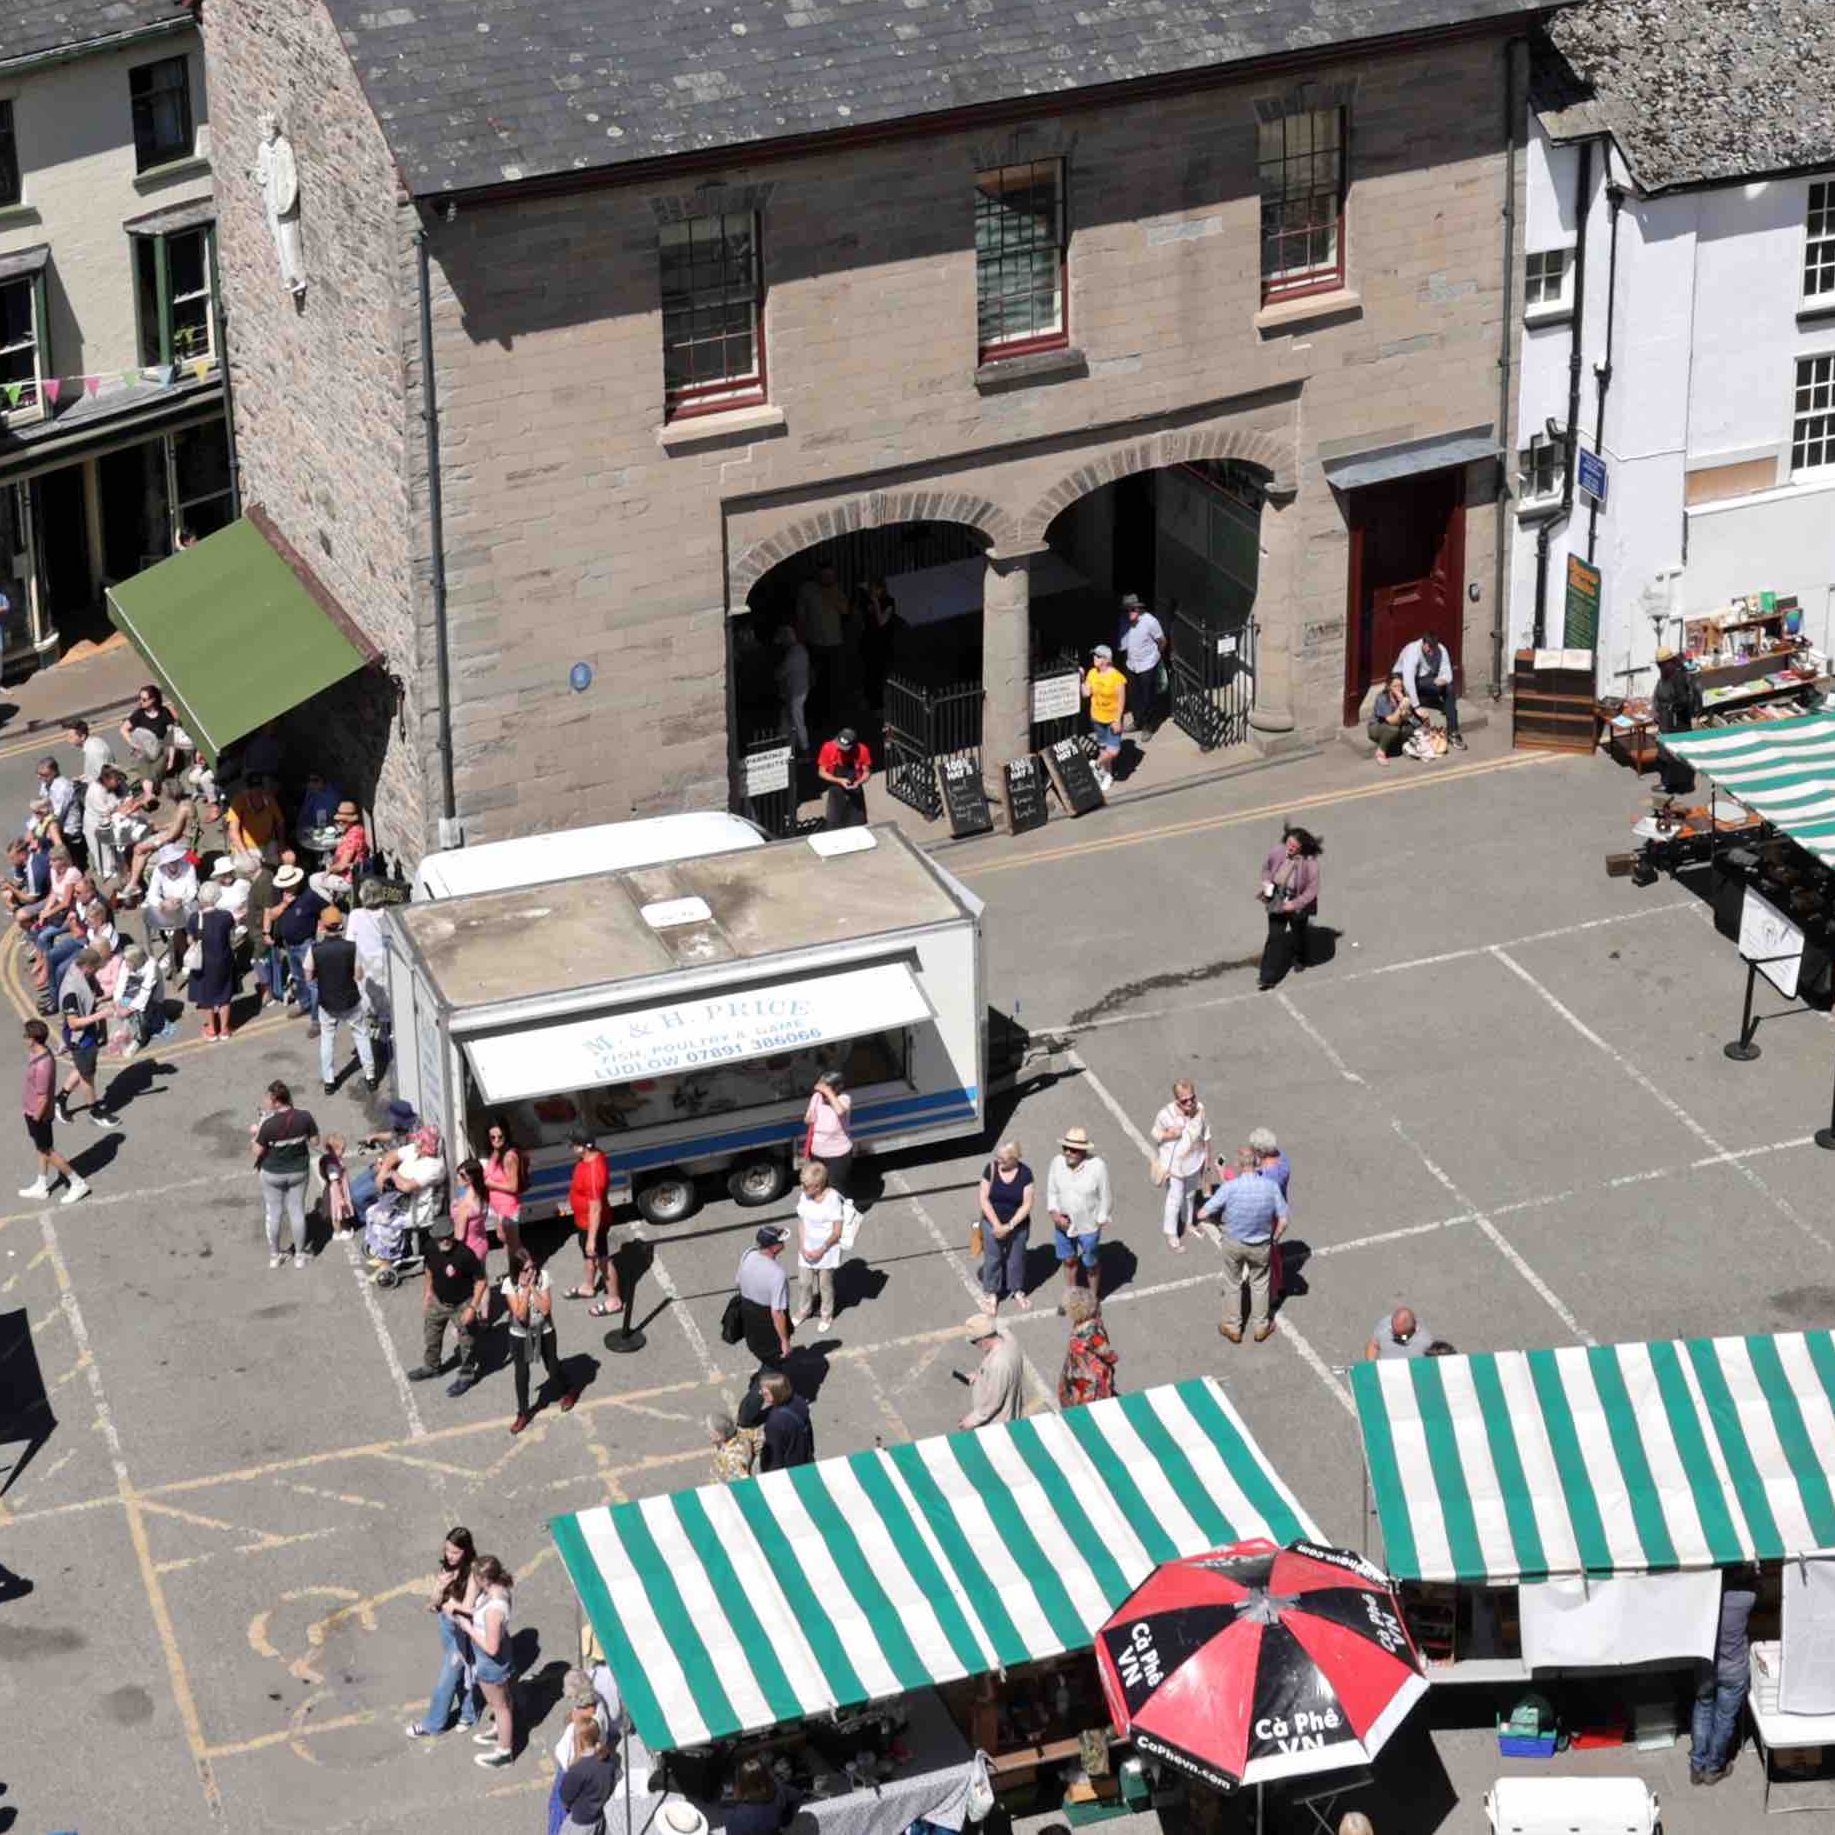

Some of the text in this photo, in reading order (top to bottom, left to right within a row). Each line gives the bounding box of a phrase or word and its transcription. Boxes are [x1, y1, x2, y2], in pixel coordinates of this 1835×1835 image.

[629, 1021, 654, 1039] &
[704, 999, 812, 1020] PRICE
[652, 1033, 728, 1056] POULTRY
[755, 1019, 806, 1036] GAME
[593, 1028, 823, 1080] LUDLOW 07891 386066
[1117, 1646, 1143, 1689] VN
[1131, 1622, 1165, 1688] Cà Phê
[1255, 1708, 1341, 1741] Cà Phê
[1278, 1732, 1326, 1757] VN
[1136, 1736, 1231, 1791] CaPhevn.com
